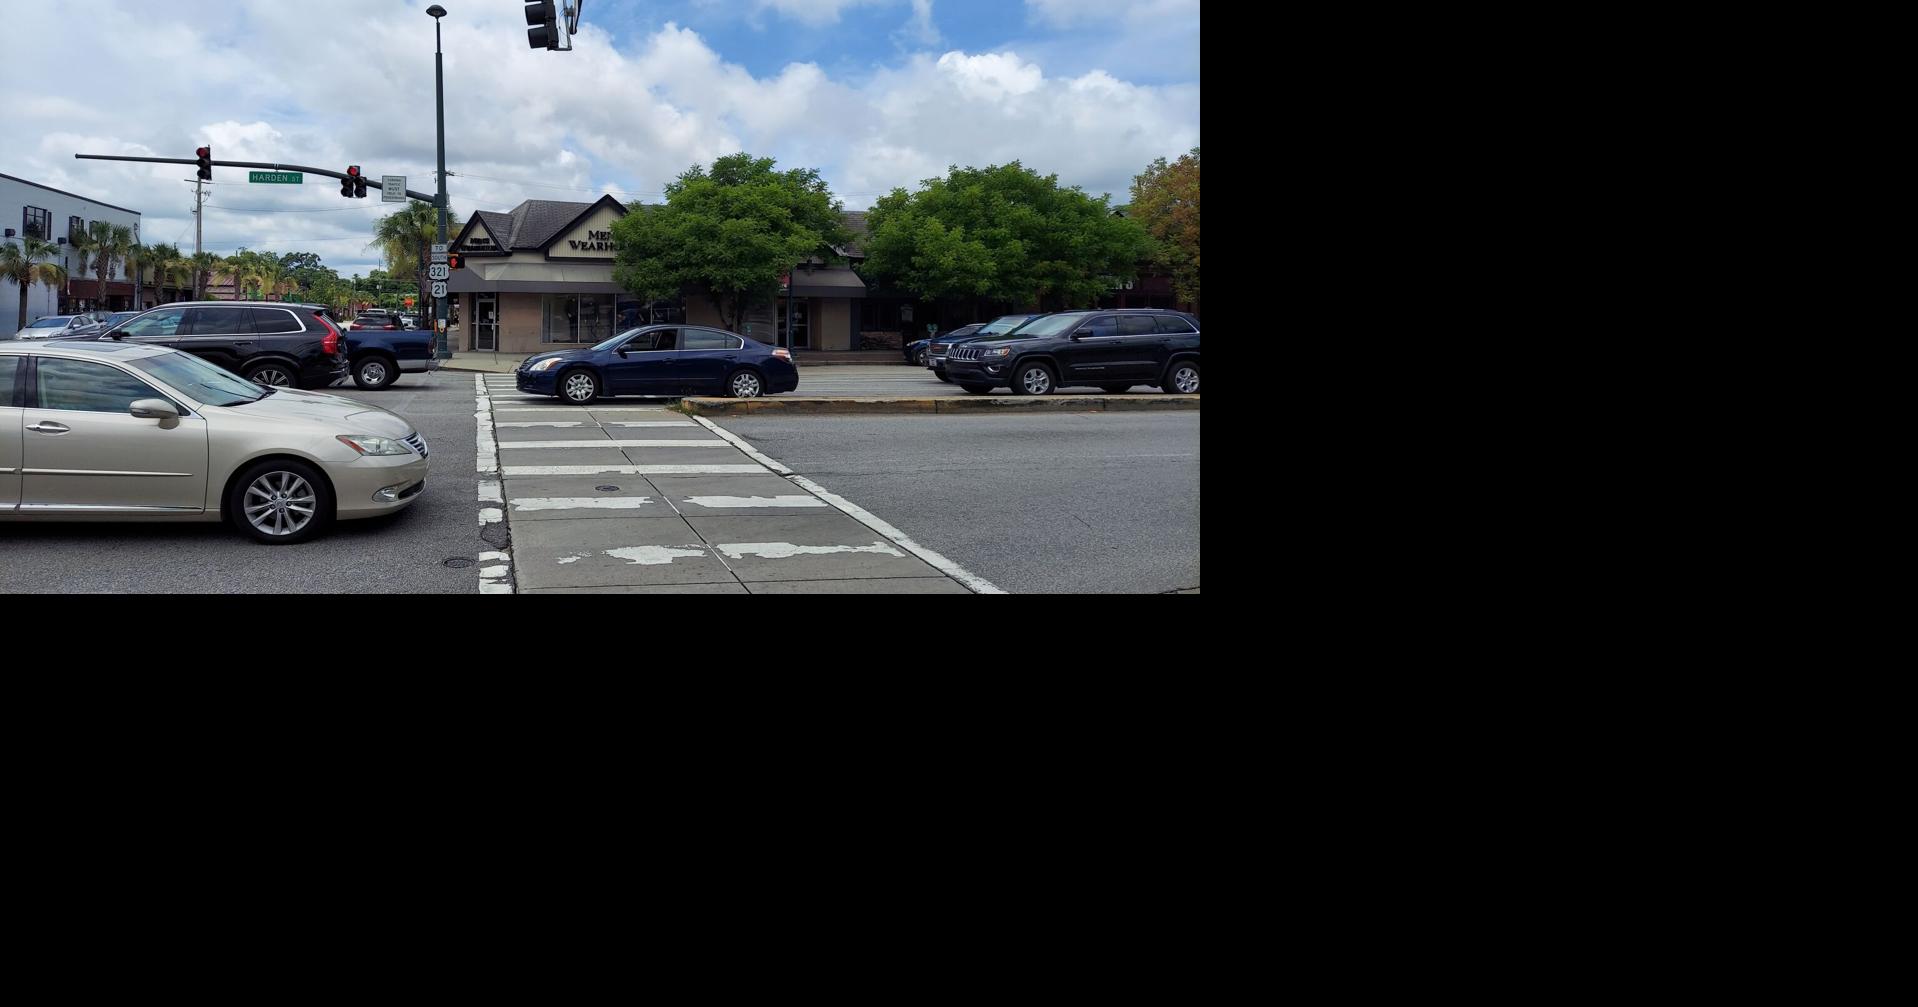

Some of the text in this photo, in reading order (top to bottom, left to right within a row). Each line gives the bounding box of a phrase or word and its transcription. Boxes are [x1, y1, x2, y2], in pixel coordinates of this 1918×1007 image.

[252, 173, 288, 182] HARDEN
[430, 266, 446, 277] 321
[434, 284, 445, 295] 21
